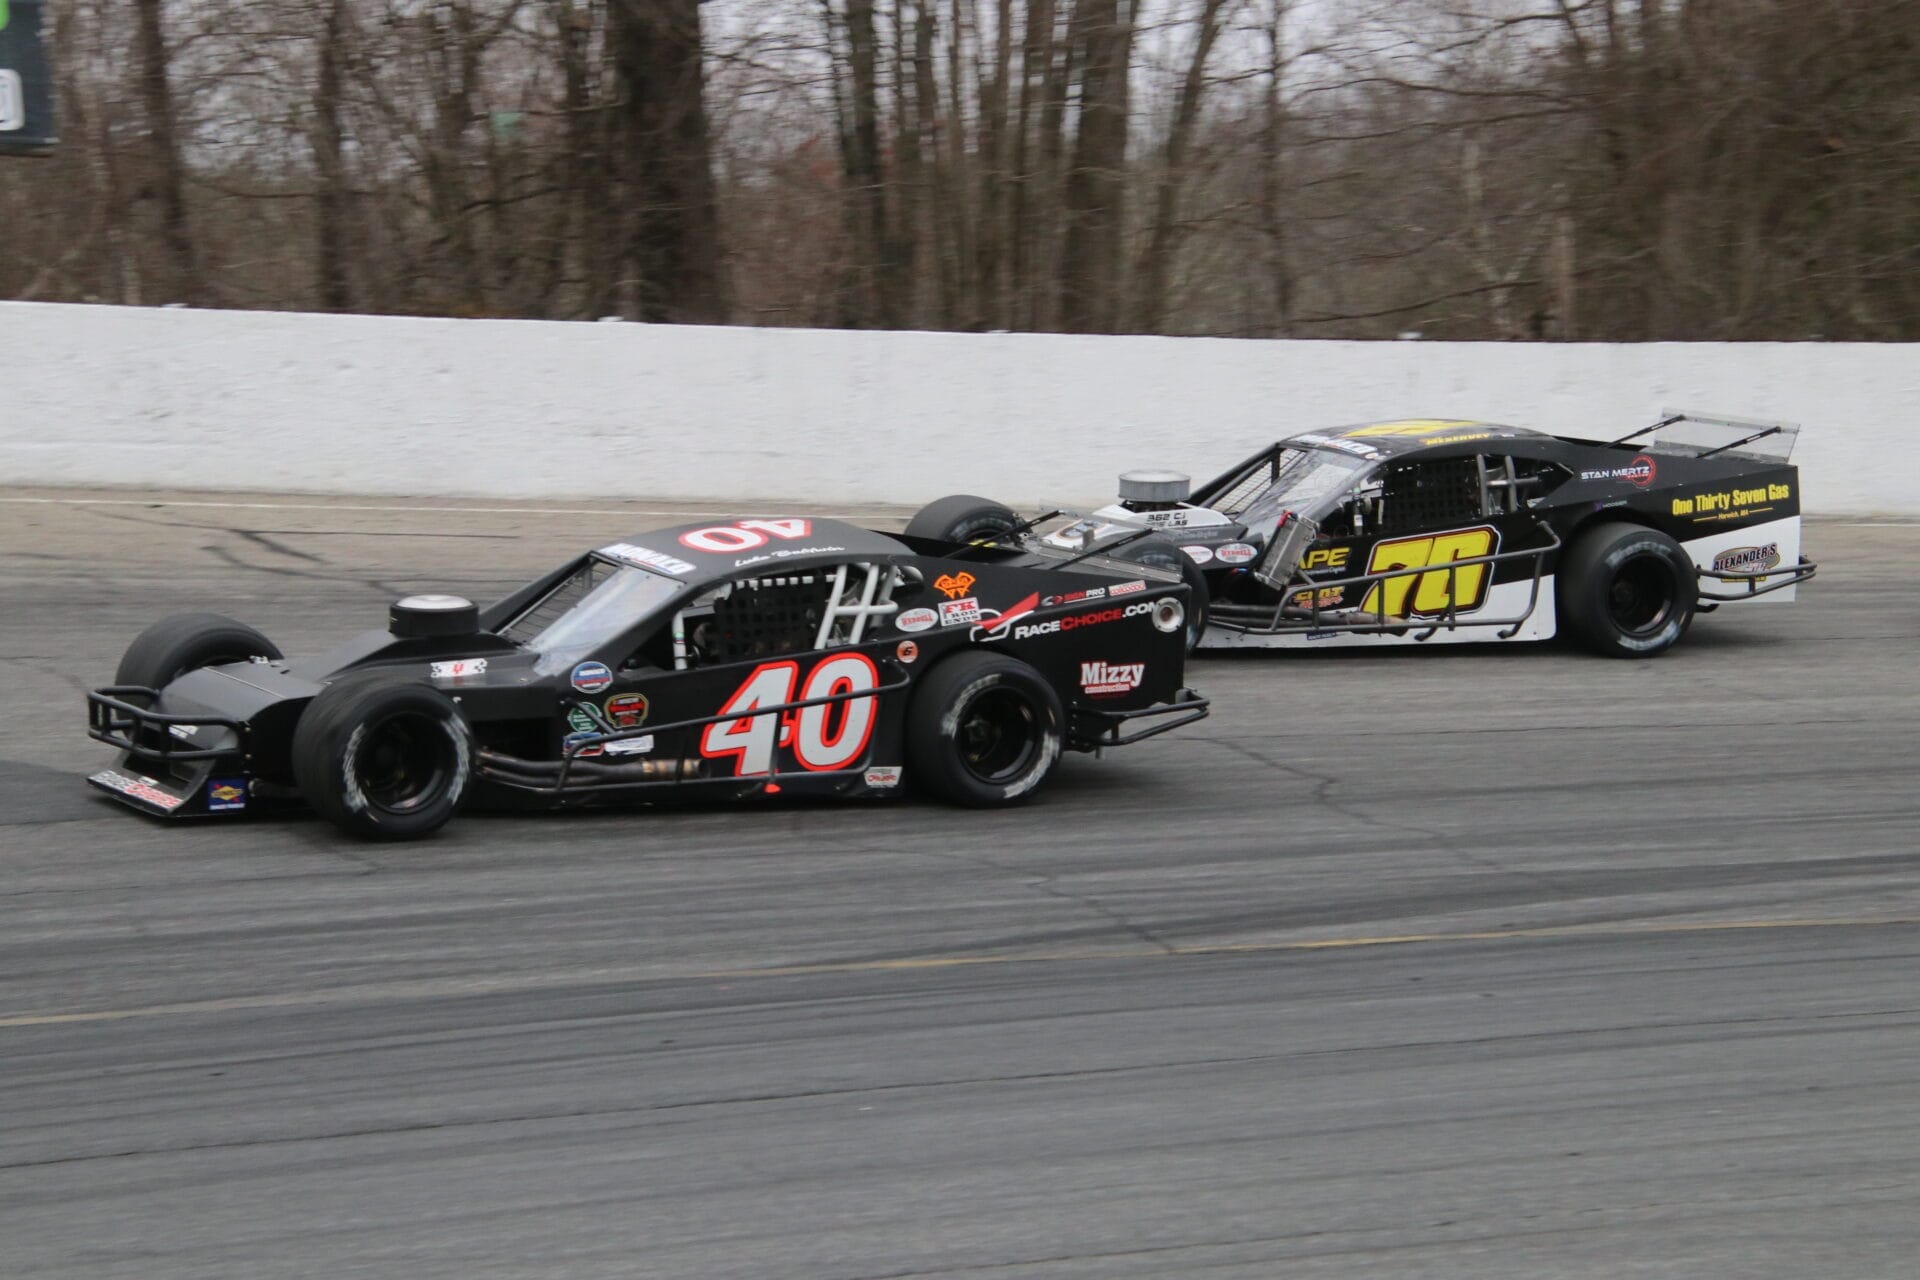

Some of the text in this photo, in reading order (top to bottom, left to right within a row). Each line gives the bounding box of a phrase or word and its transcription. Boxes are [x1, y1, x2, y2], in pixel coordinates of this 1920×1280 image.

[1581, 470, 1610, 480] STAN
[1611, 466, 1650, 477] MERTZ
[1672, 484, 1789, 516] One Thirty Seven Gas
[1300, 547, 1350, 570] PE
[1713, 543, 1777, 572] ALEXANDER'S
[944, 615, 979, 625] ENDS
[951, 610, 978, 618] ROD
[1080, 661, 1145, 688] Mizzy
[700, 652, 879, 777] 40
